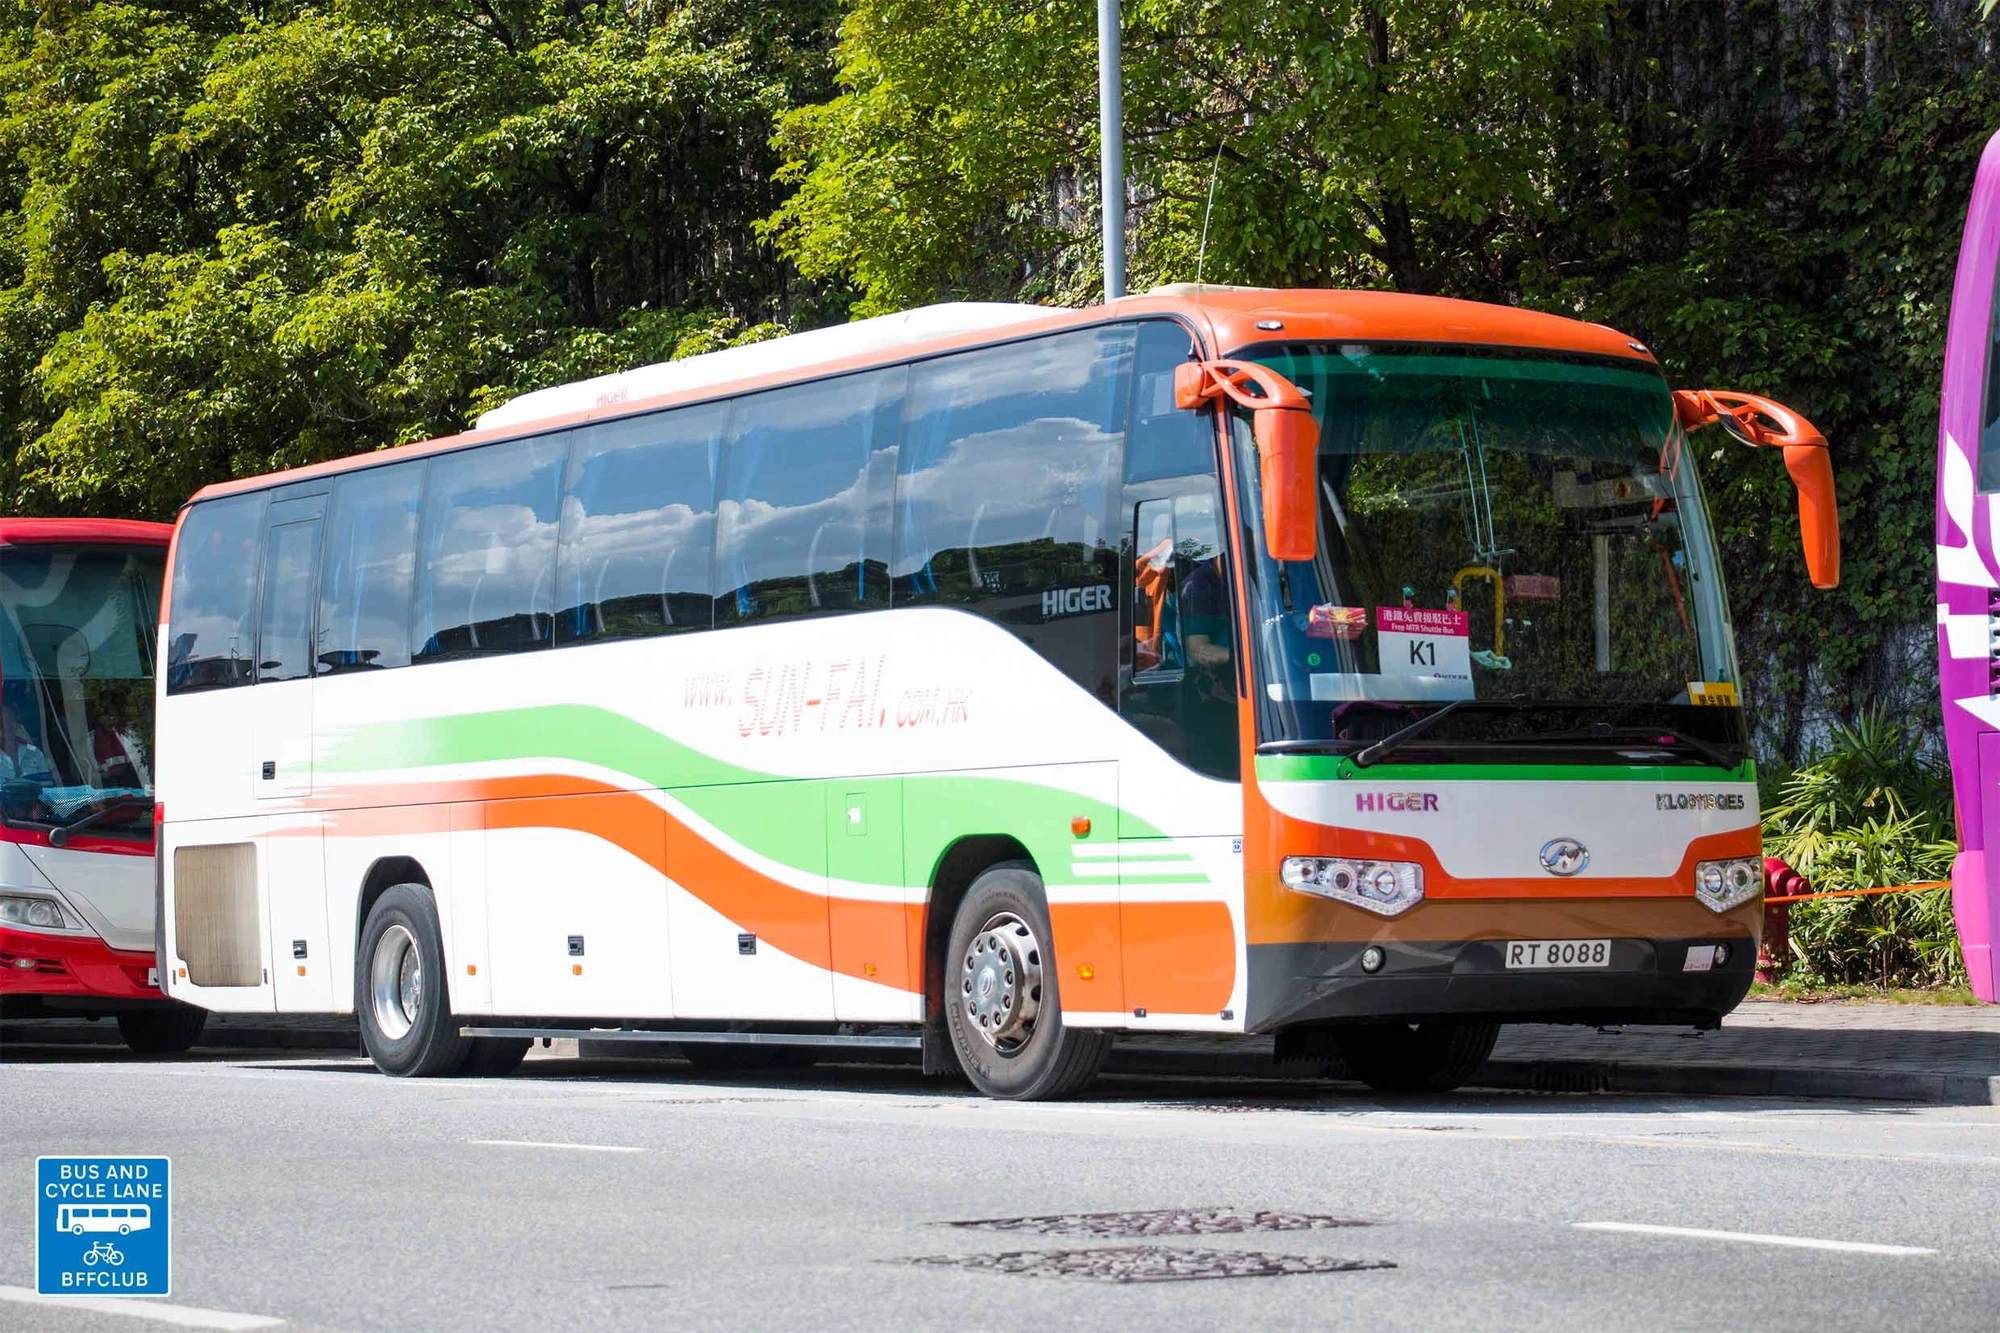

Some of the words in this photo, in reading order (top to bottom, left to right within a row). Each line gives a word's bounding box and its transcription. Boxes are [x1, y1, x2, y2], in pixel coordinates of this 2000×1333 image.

[596, 388, 628, 407] HIGER
[1041, 585, 1112, 615] HIGER
[1383, 609, 1462, 625] 港鐵免費接駁巴士
[1391, 623, 1405, 631] Free
[1406, 624, 1420, 632] MTR
[1421, 625, 1442, 633] Shuttle
[1410, 640, 1436, 666] K1
[1356, 793, 1439, 812] HIGER
[1510, 944, 1541, 965] RT
[1547, 943, 1606, 964] 8088
